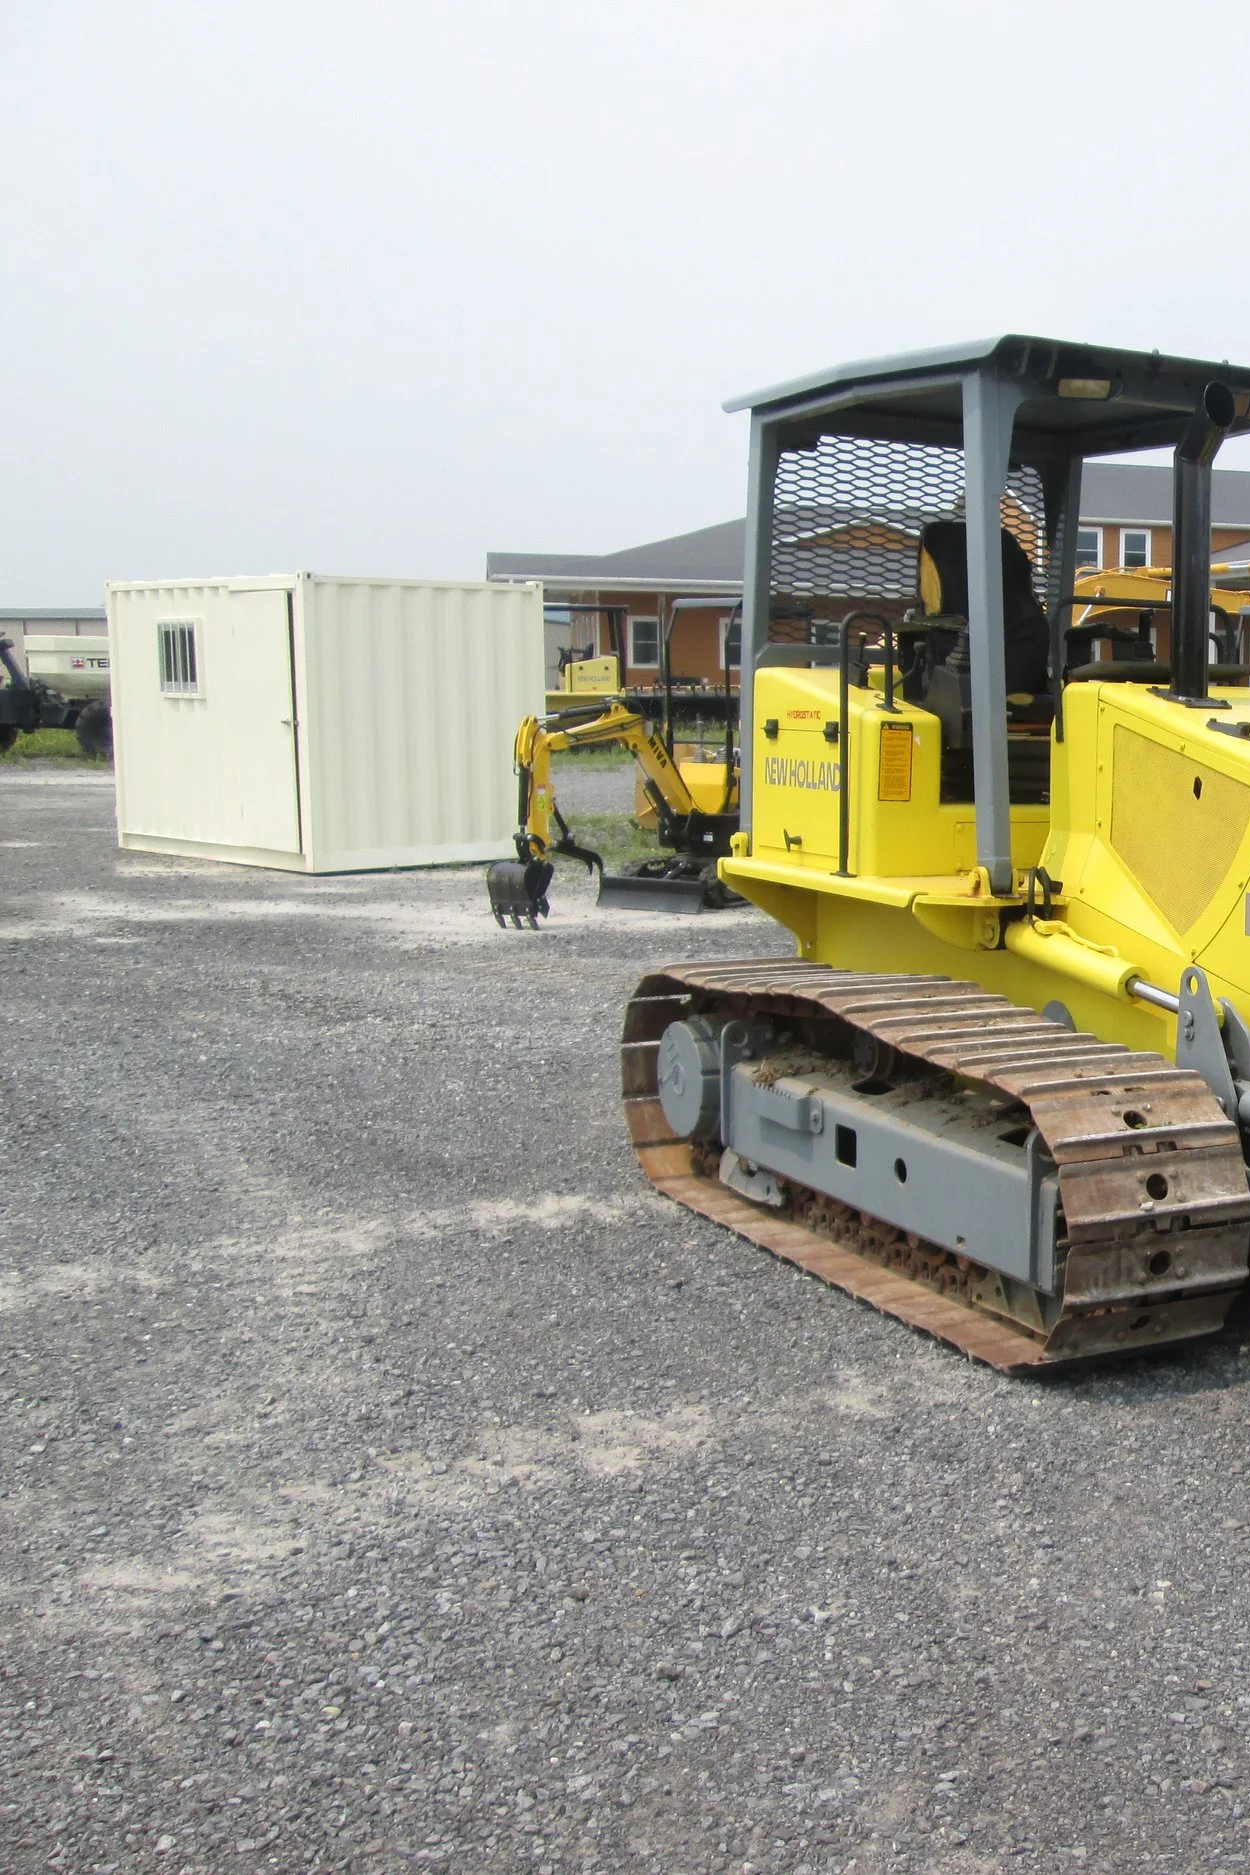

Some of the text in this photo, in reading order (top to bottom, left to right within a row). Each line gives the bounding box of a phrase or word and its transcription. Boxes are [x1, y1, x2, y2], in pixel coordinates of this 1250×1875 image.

[786, 710, 821, 720] HYDROSTATIC
[647, 737, 668, 769] MIVA
[764, 757, 841, 792] NEW HOLLAND
